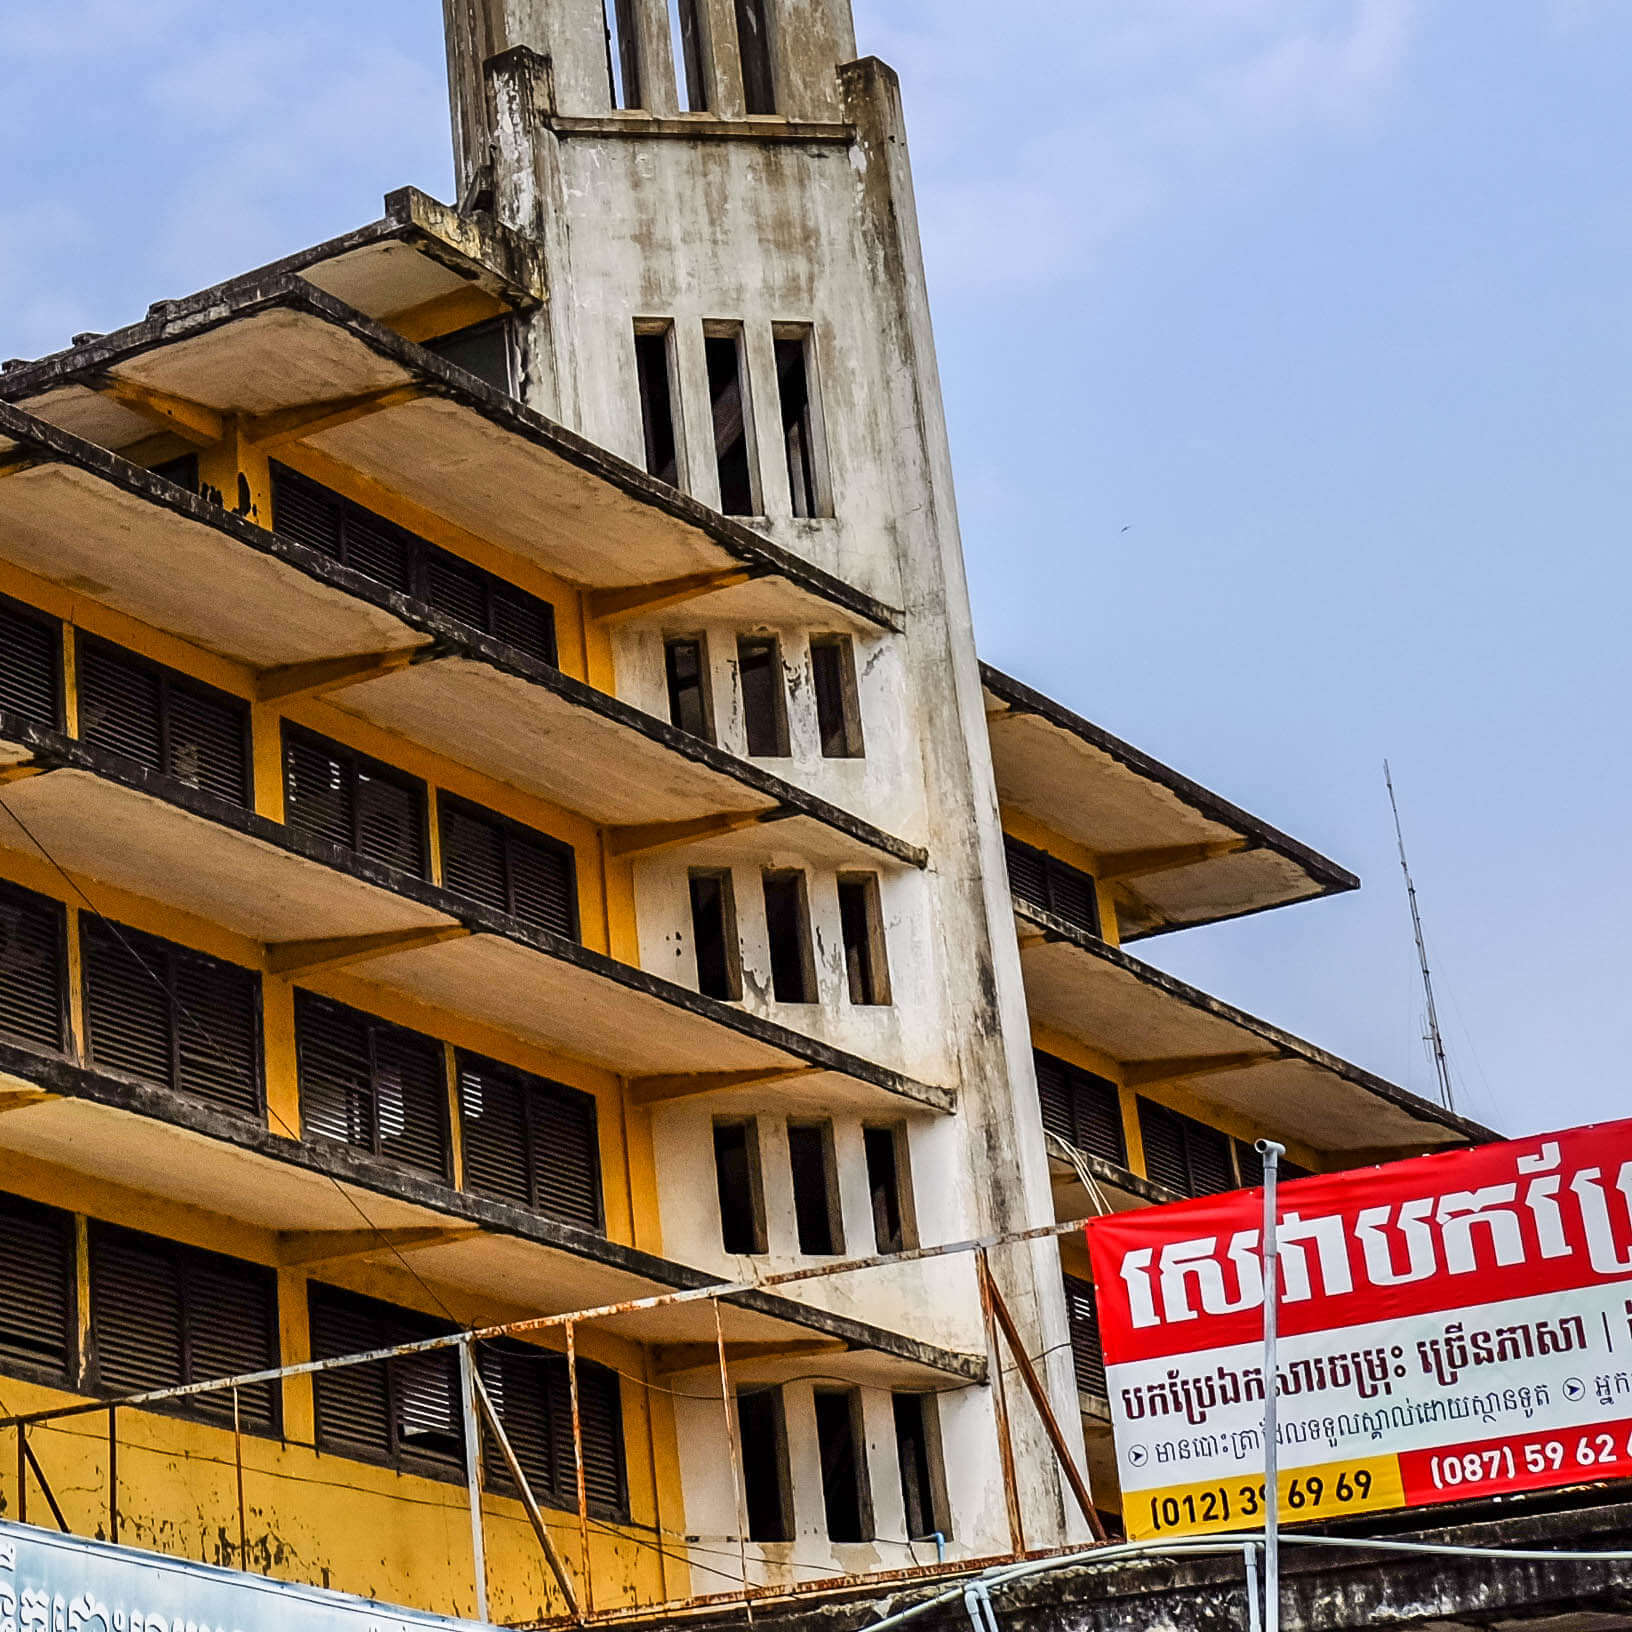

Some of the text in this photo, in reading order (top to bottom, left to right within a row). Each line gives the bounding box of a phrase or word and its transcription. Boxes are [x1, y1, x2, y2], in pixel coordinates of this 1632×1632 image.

[1120, 1141, 1632, 1329] សេវាបក្រែ
[1416, 1315, 1588, 1386] ច្រើនភាសា
[1430, 1445, 1515, 1489] (087)
[1524, 1441, 1564, 1473] 59
[1575, 1433, 1617, 1466] 62
[1151, 1487, 1230, 1531] (012)
[1288, 1476, 1324, 1508] 69
[1336, 1469, 1372, 1502] 69
